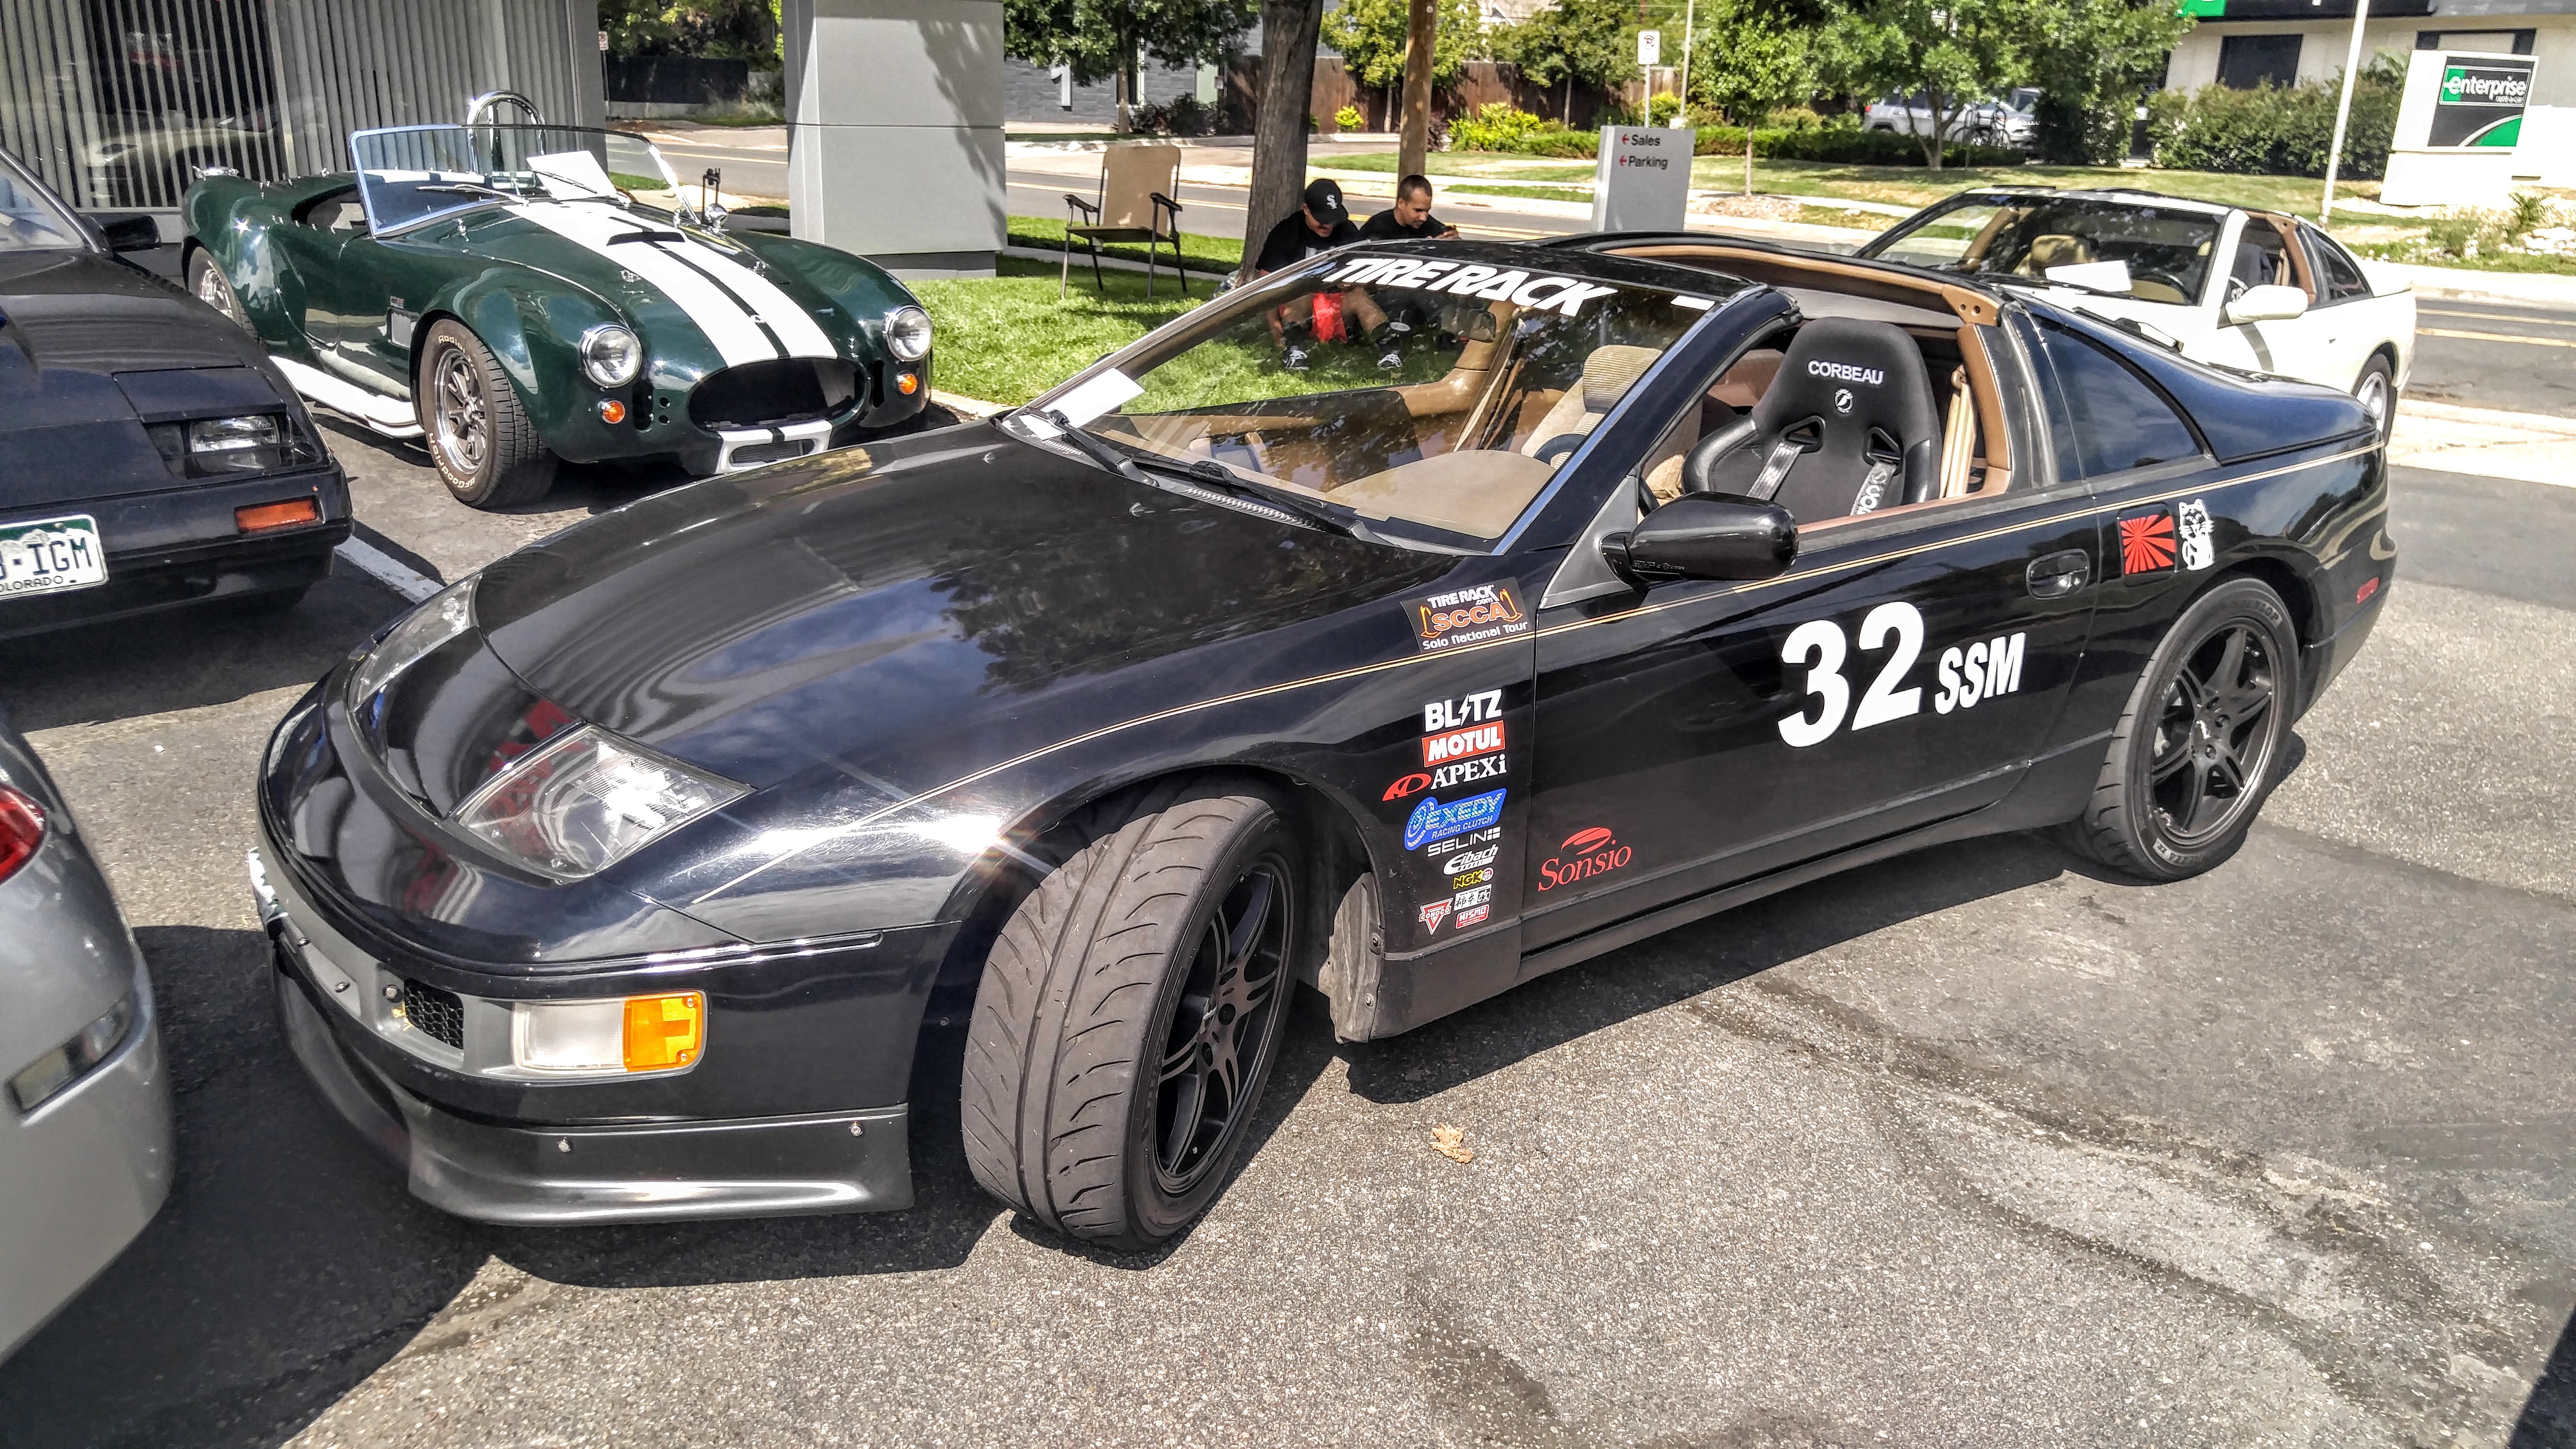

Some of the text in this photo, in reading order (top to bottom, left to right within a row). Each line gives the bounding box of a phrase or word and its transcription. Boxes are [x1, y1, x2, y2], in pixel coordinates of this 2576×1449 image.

[2444, 75, 2526, 100] enterprise
[1631, 134, 1661, 146] Sales
[1628, 155, 1668, 170] Parking
[1807, 360, 1884, 386] CORBEAU
[429, 433, 476, 488] BFGoodrich
[1475, 597, 1494, 606] .com
[1431, 601, 1509, 631] SCCA
[1422, 638, 1449, 650] Solo
[1502, 621, 1528, 634] Tour
[1777, 601, 2027, 748] 32 SSM
[1424, 689, 1502, 733] BLITZ
[1427, 725, 1502, 762] MOTUL
[1425, 792, 1503, 830] EXEDY
[1431, 814, 1493, 839] RACING CLUTCH
[1443, 843, 1499, 875] Eibach
[1537, 839, 1632, 892] Sonsio
[1452, 869, 1484, 890] NGK
[1420, 907, 1450, 920] CONOCO
[1458, 906, 1487, 922] NISMO
